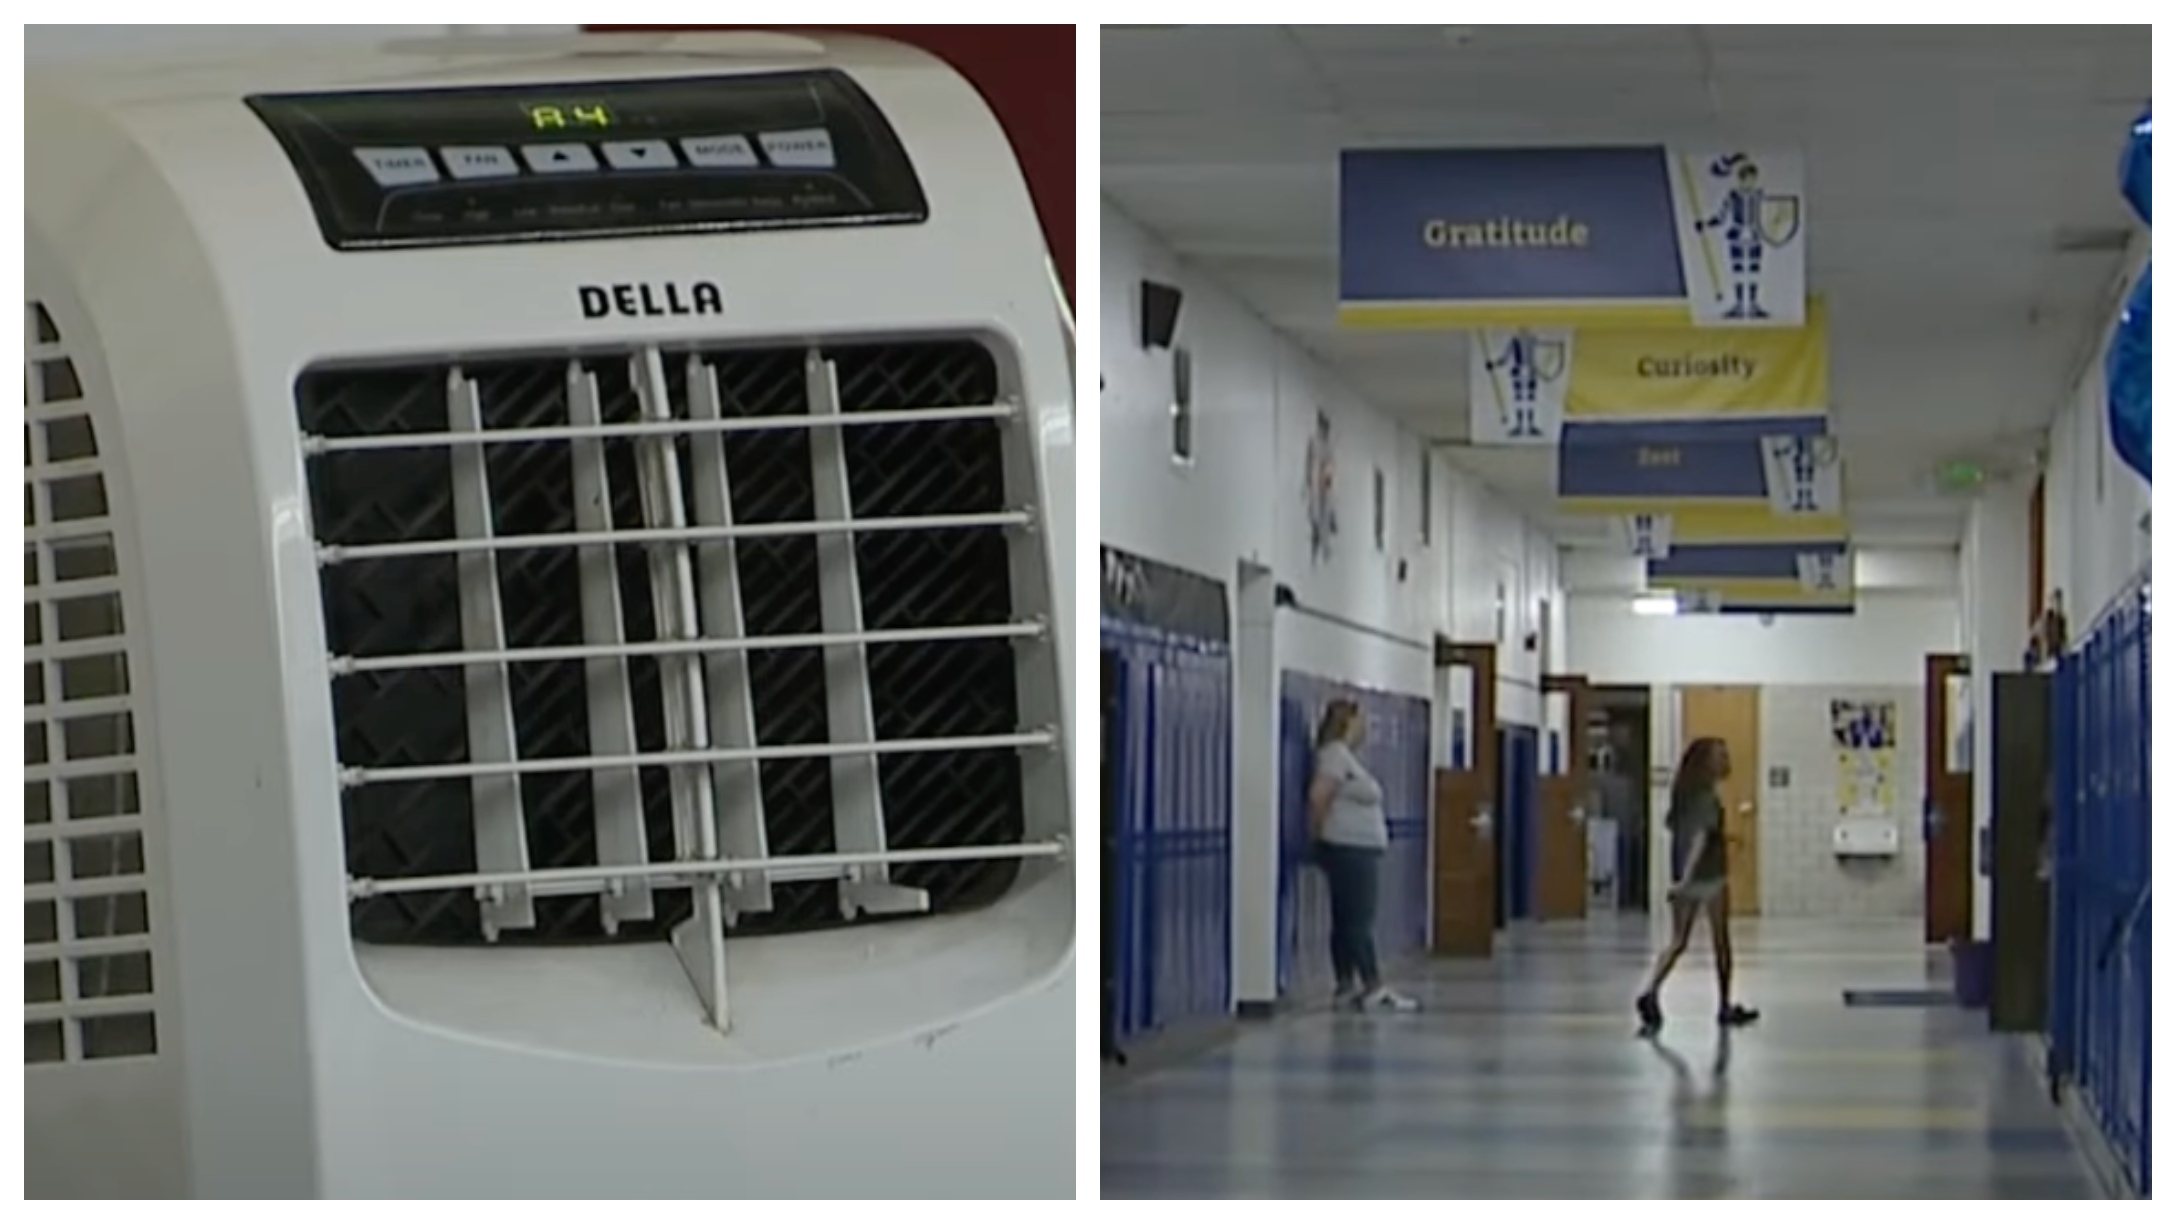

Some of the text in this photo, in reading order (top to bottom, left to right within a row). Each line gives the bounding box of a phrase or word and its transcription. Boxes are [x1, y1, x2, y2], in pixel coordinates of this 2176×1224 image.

[1424, 213, 1588, 248] Gratitude
[578, 281, 724, 319] DELLA
[1637, 351, 1758, 381] Curiosity
